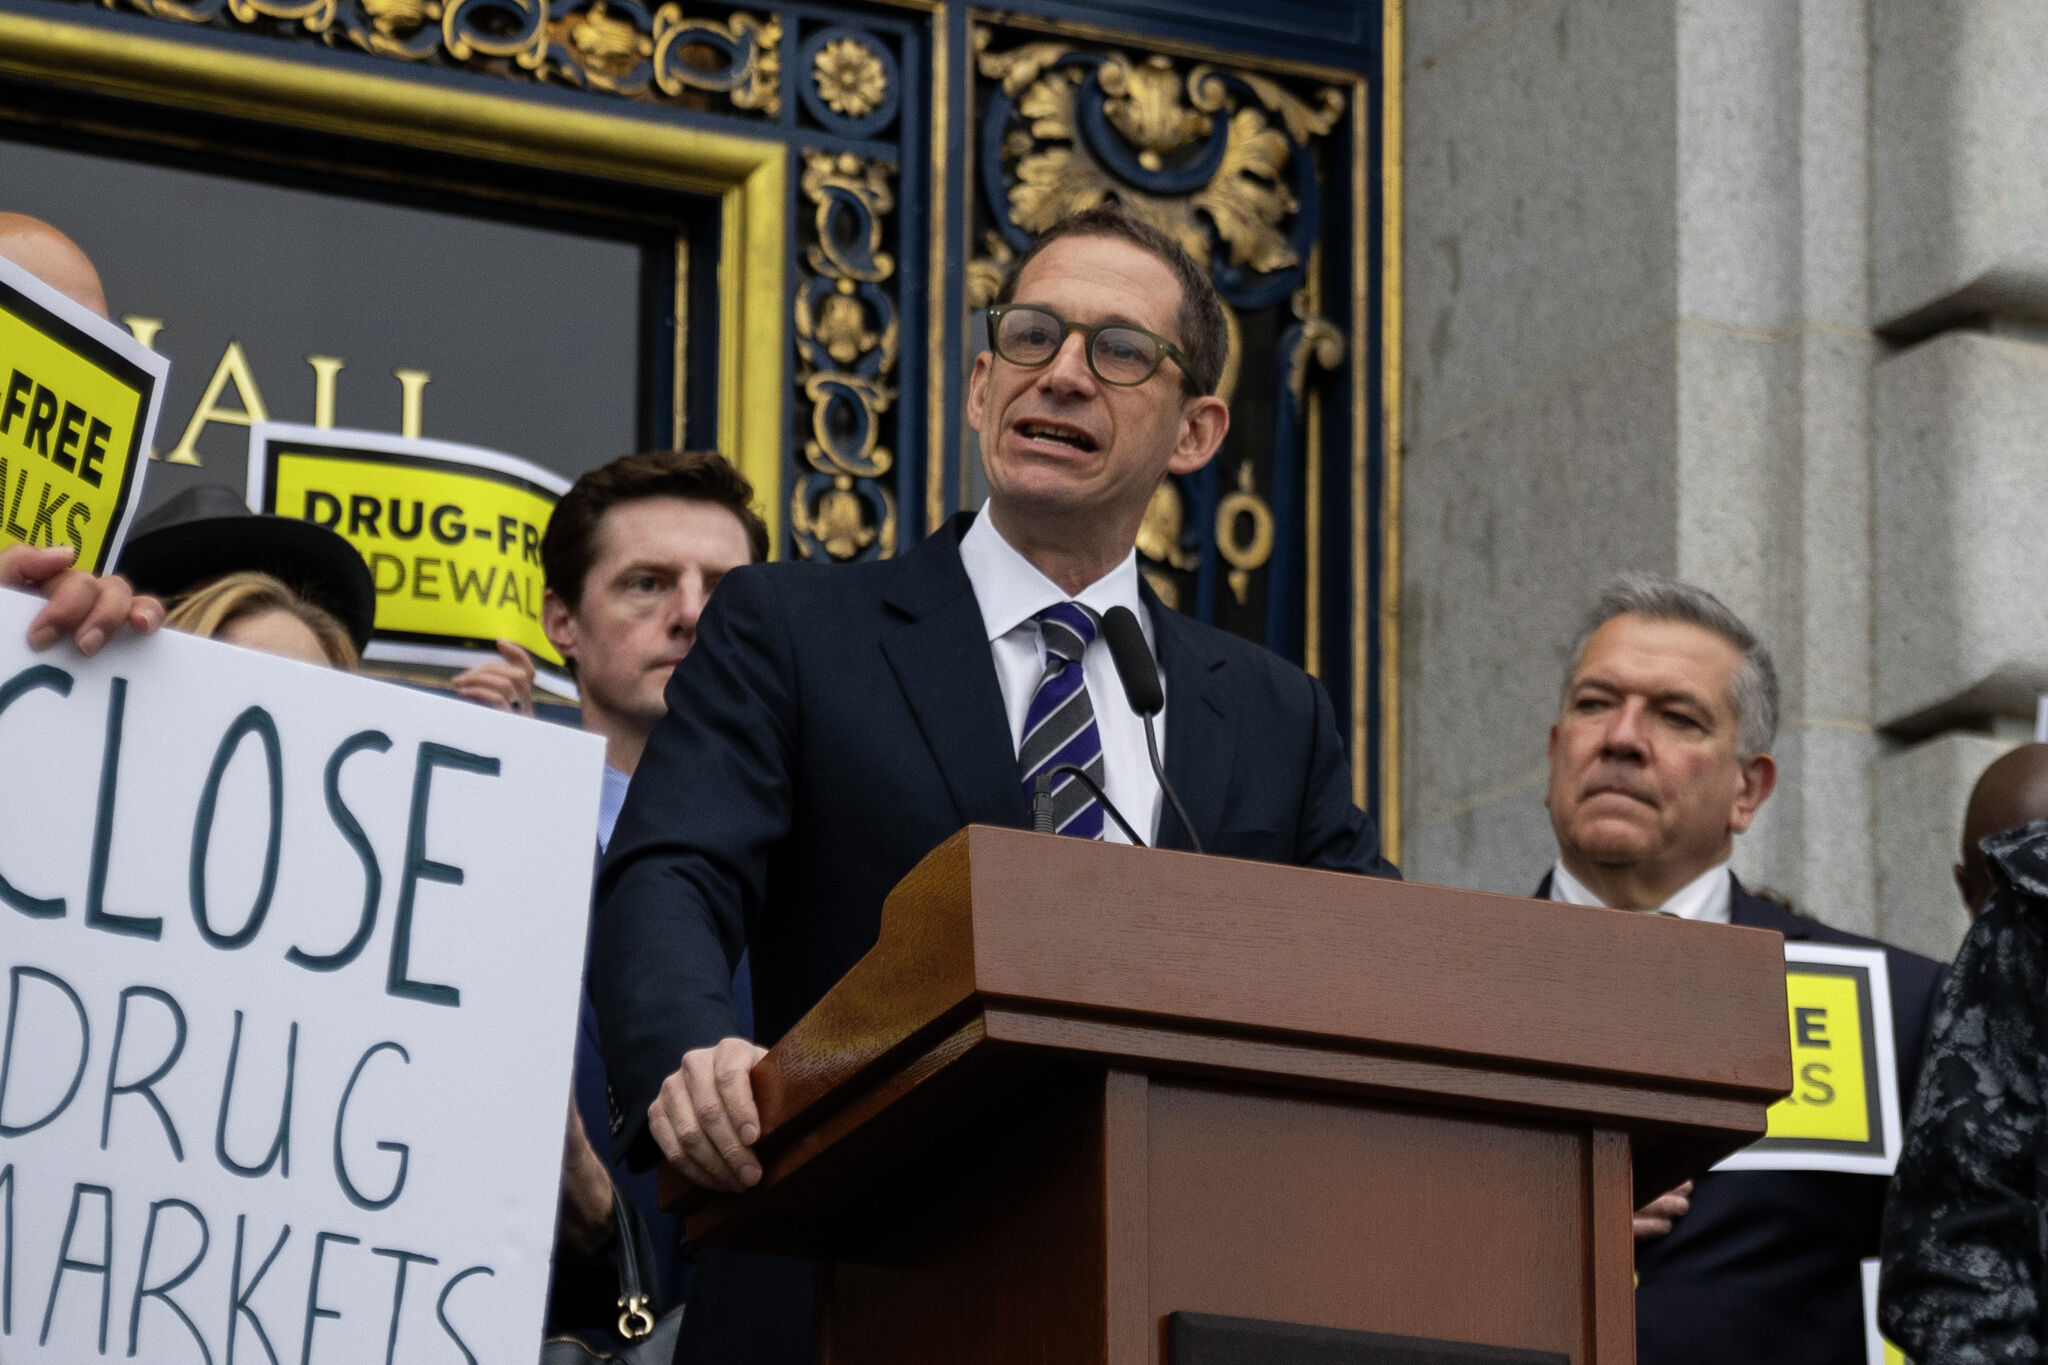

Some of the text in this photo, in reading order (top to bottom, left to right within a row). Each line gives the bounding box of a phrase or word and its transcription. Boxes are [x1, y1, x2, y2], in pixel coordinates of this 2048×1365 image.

[0, 368, 112, 489] FREE
[304, 490, 541, 567] DRUG-FR
[366, 553, 544, 623] DEWAL
[0, 965, 410, 1211] DRUG
